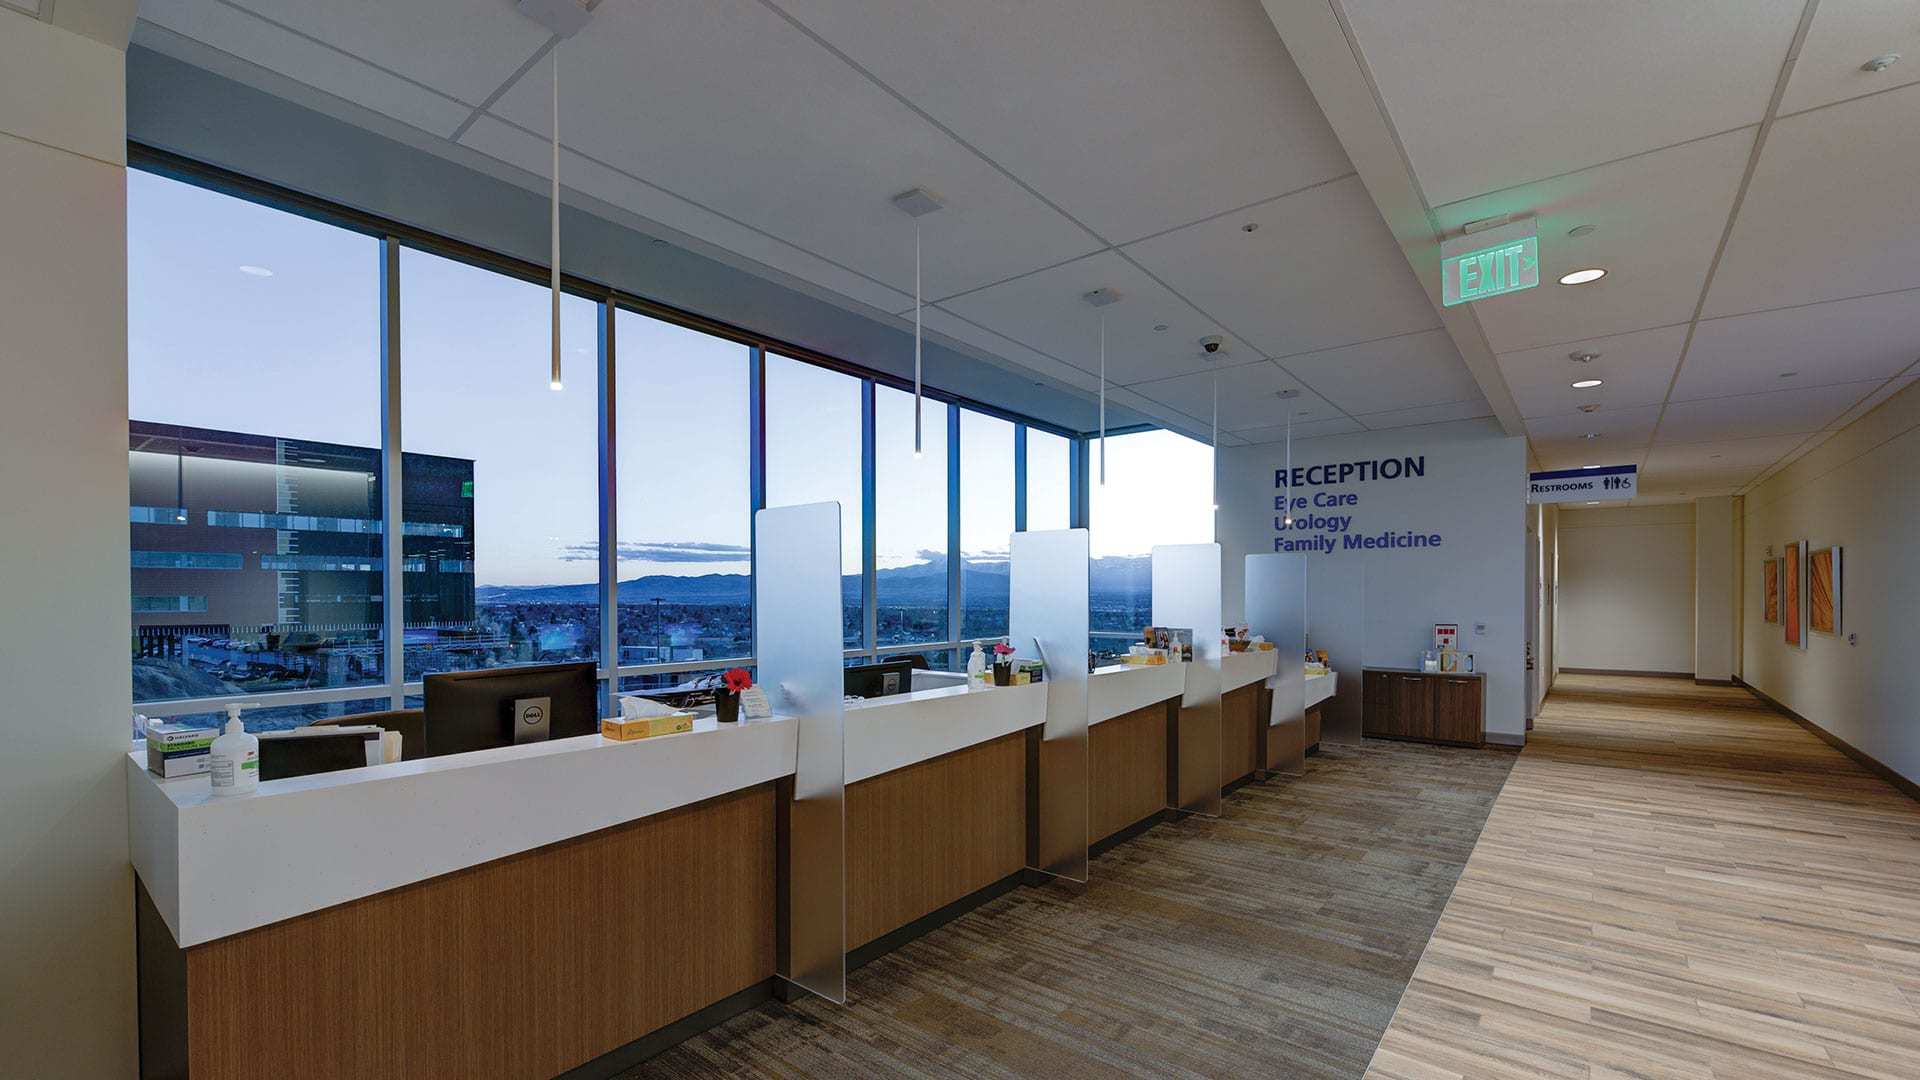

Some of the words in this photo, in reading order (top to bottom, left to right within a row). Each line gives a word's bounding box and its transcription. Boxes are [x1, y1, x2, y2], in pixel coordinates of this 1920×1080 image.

[1460, 244, 1523, 298] EXIT
[1275, 456, 1424, 488] RECEPTION
[1313, 493, 1358, 507] Care
[1274, 534, 1336, 554] Family
[1343, 531, 1442, 550] Medicine
